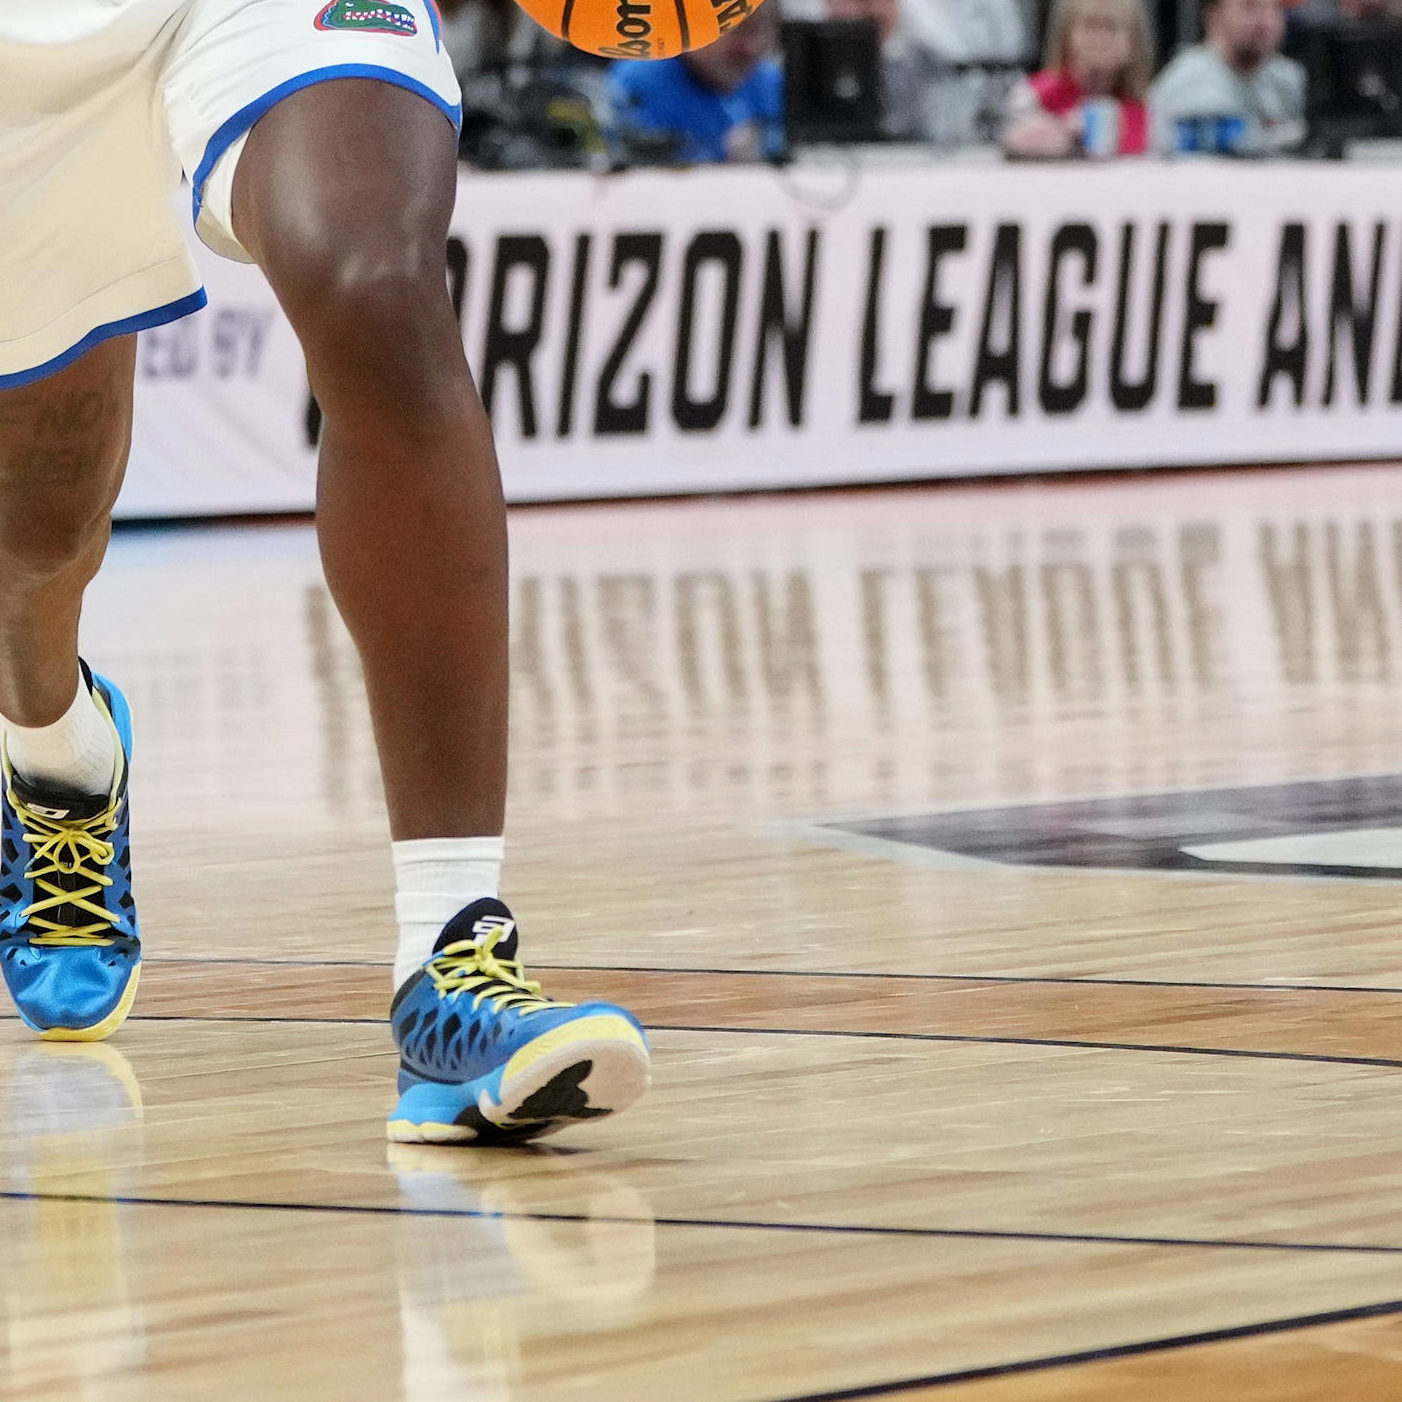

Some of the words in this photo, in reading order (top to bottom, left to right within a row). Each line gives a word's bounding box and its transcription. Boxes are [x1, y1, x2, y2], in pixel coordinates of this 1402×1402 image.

[306, 225, 821, 448] RIZON
[856, 220, 1230, 425] LEAGUE
[1256, 219, 1402, 410] AN
